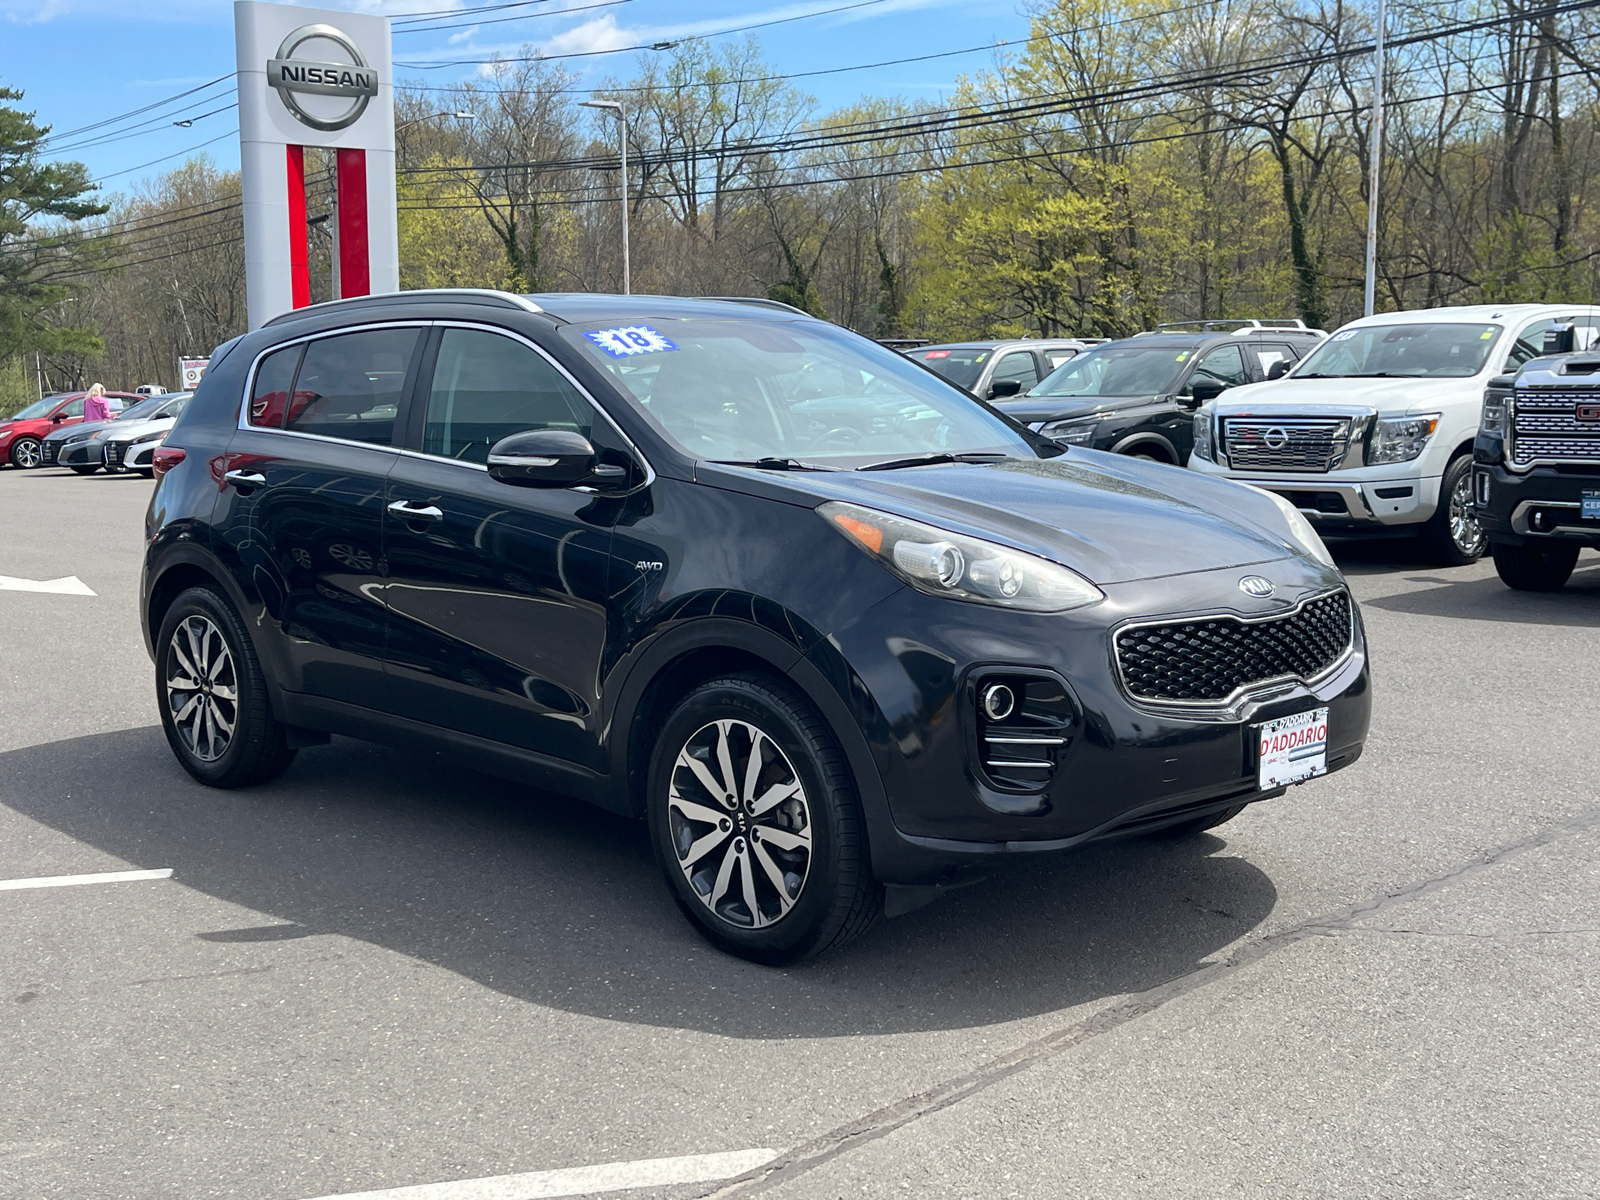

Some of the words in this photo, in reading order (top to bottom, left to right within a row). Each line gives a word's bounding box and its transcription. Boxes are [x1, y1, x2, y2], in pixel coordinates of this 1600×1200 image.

[281, 66, 370, 89] NISSAN
[611, 331, 651, 349] 18
[634, 561, 663, 570] AWD
[1243, 578, 1273, 594] KIA
[1280, 712, 1314, 729] D'ADDARIO
[1260, 724, 1327, 757] D'ADDARIO
[737, 812, 747, 833] KIA
